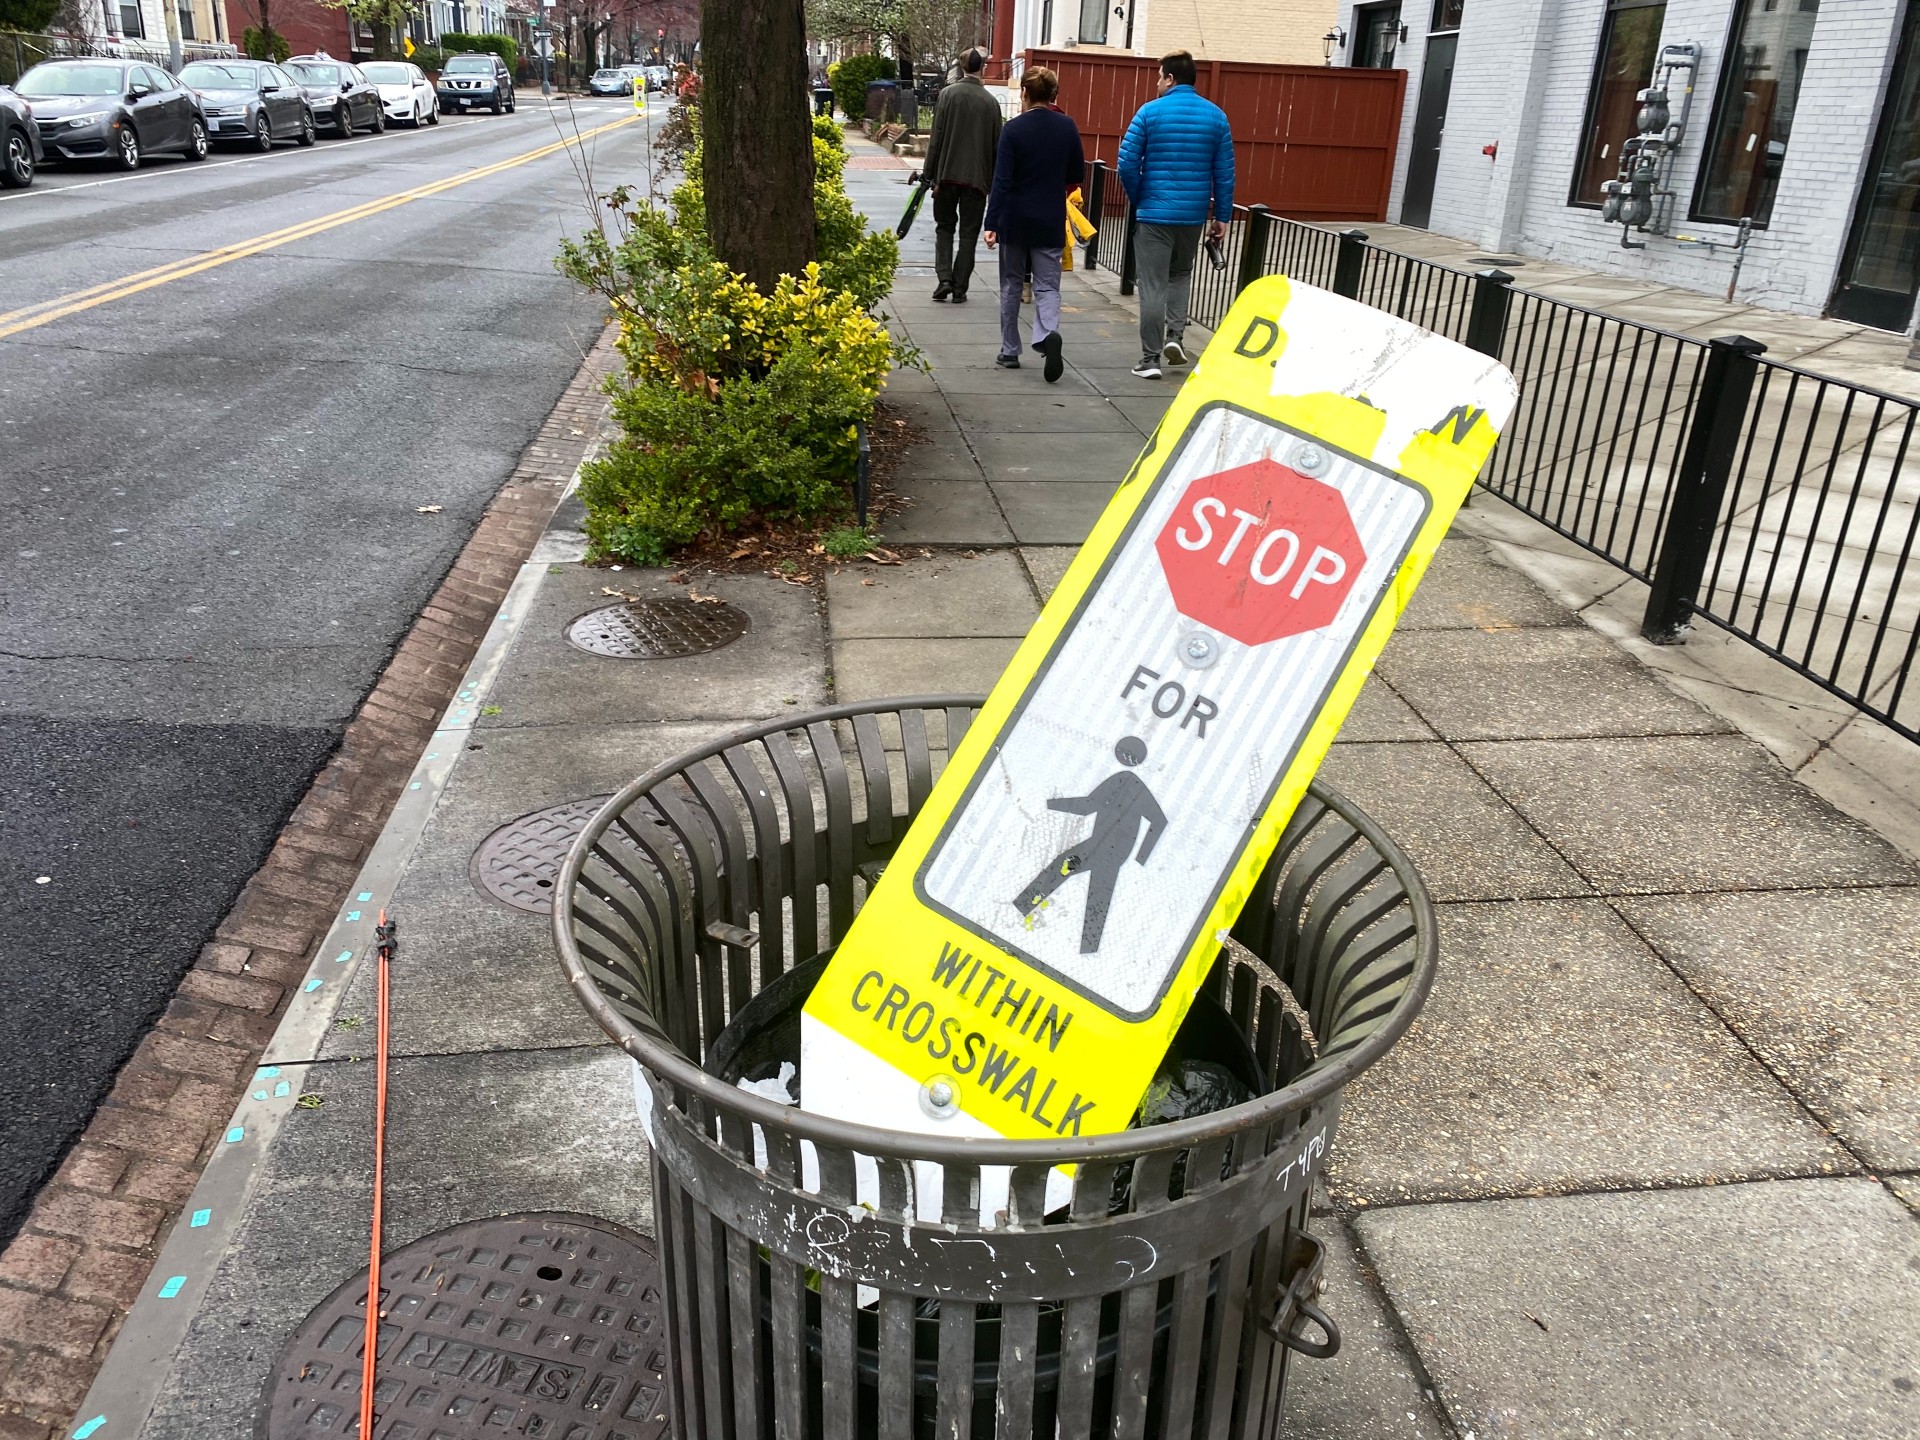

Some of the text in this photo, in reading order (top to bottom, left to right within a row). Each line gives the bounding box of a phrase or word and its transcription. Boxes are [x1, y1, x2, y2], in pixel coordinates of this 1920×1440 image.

[1175, 496, 1347, 600] STOP
[1120, 664, 1219, 739] FOR
[931, 940, 1074, 1053] WITHIN
[851, 970, 1097, 1137] CROSSWALK
